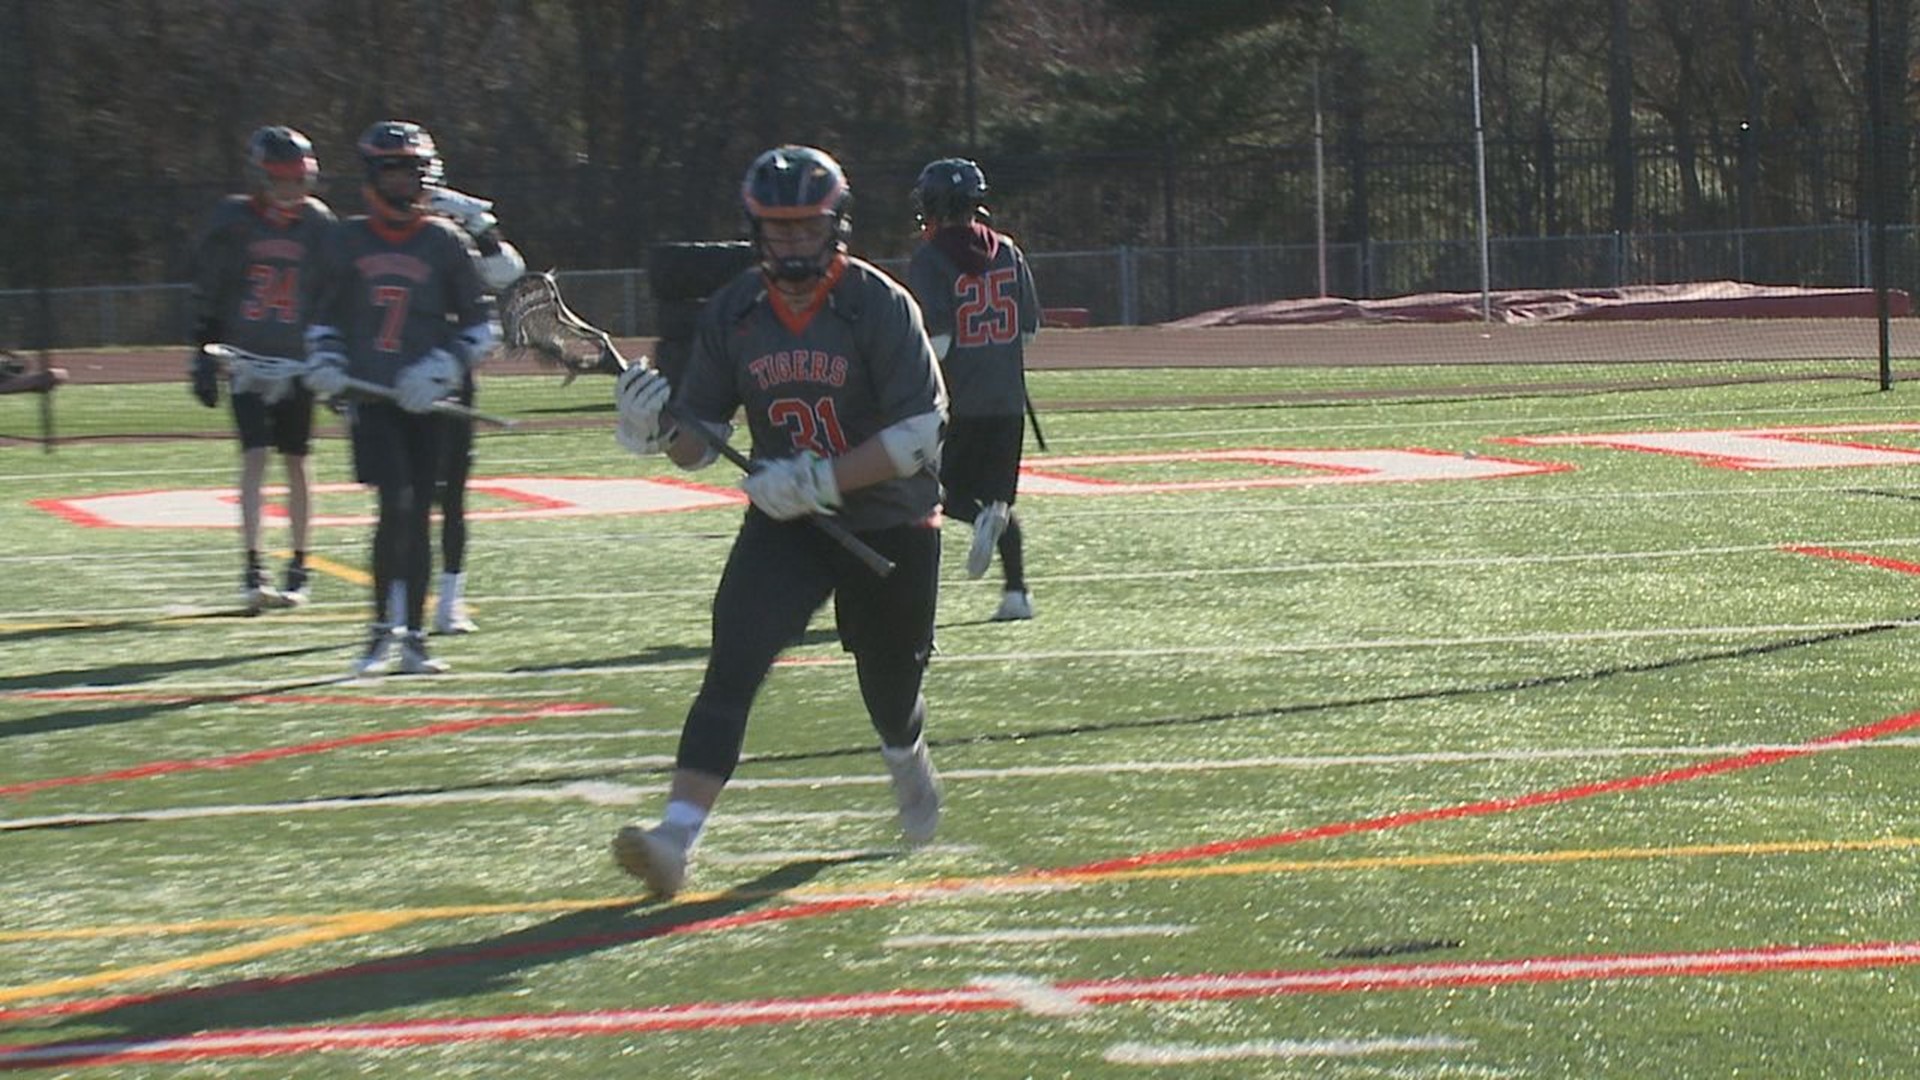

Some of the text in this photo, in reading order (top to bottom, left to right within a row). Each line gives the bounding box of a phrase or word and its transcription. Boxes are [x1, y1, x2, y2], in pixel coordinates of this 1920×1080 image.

[242, 264, 299, 323] 34
[372, 285, 410, 351] 7
[955, 267, 1018, 347] 25
[749, 349, 849, 390] TIGERS
[768, 397, 848, 458] 31
